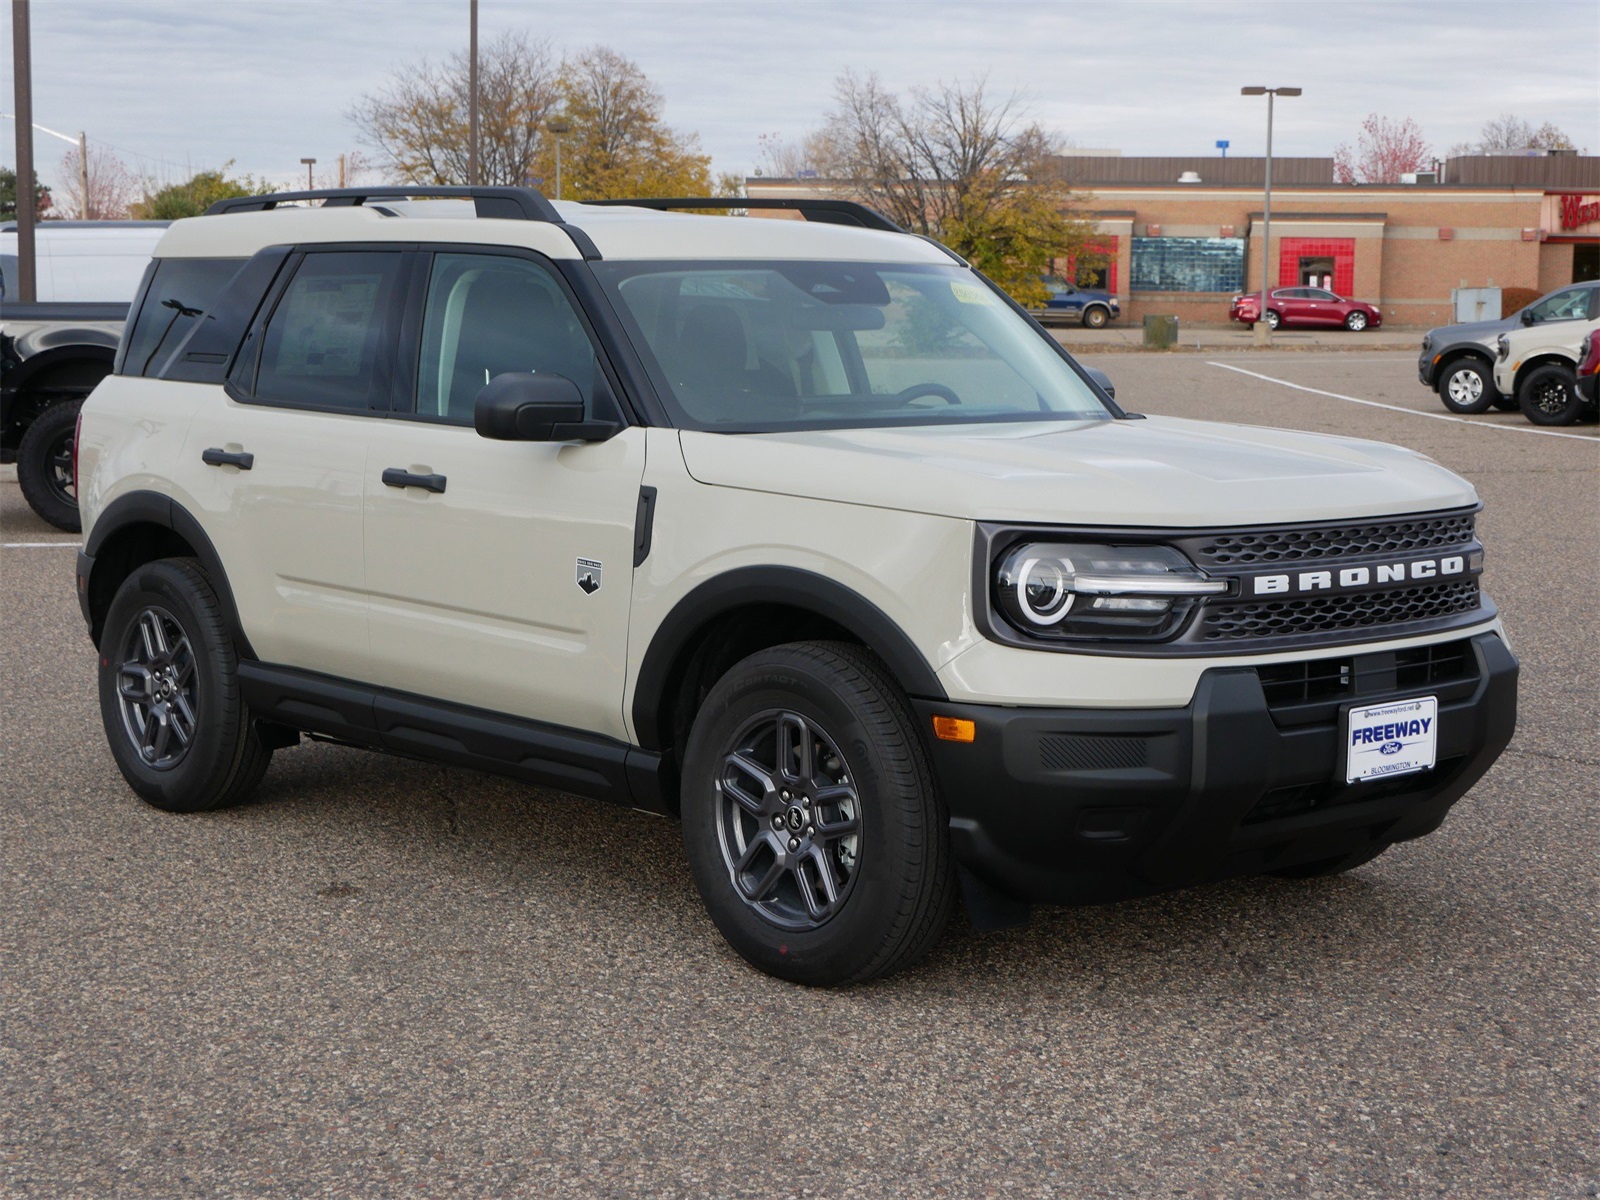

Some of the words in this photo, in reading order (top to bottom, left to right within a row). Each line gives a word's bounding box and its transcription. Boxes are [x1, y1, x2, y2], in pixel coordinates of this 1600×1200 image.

[1254, 556, 1464, 595] BRONCO
[1352, 717, 1432, 746] FREEWAY
[1382, 743, 1400, 754] Ford
[1371, 761, 1411, 774] BLOOMINGTON
